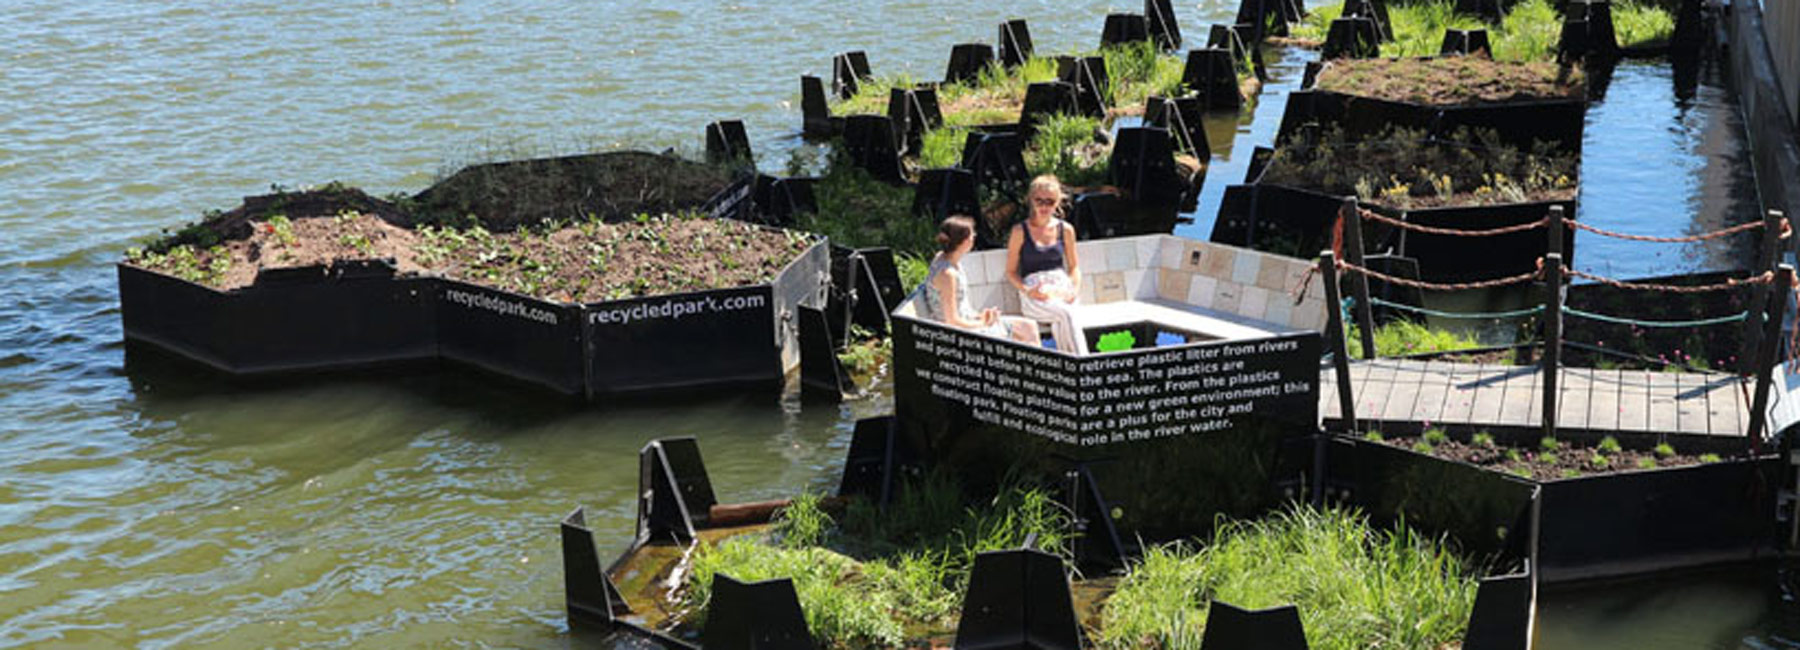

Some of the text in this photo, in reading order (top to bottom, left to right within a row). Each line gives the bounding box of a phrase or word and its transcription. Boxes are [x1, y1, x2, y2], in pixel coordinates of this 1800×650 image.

[446, 290, 557, 325] recycledpark.com
[589, 294, 764, 324] recycledpark.com
[912, 324, 1297, 372] Recycled park is the proposal to retrieve plastic litter from rivers
[915, 340, 1244, 387] and ports just before it reaches the sea. The plastics are
[915, 368, 931, 380] we
[933, 373, 981, 393] construct
[983, 382, 1023, 402] floating
[1026, 394, 1077, 415] platforms
[1080, 404, 1100, 416] for
[1104, 403, 1112, 413] a
[1116, 400, 1145, 412] new
[1148, 394, 1188, 410] green
[1284, 380, 1309, 393] this
[939, 361, 1280, 402] recycled to give new value to the river. From the plastics
[932, 384, 1253, 431] floating park. Floating parks are a plus for the city and
[1003, 417, 1022, 430] and
[1025, 423, 1078, 445] ecological
[1081, 433, 1107, 446] role
[1111, 430, 1125, 442] in
[1128, 427, 1151, 440] the
[1154, 424, 1186, 437] river
[1190, 419, 1233, 432] water.
